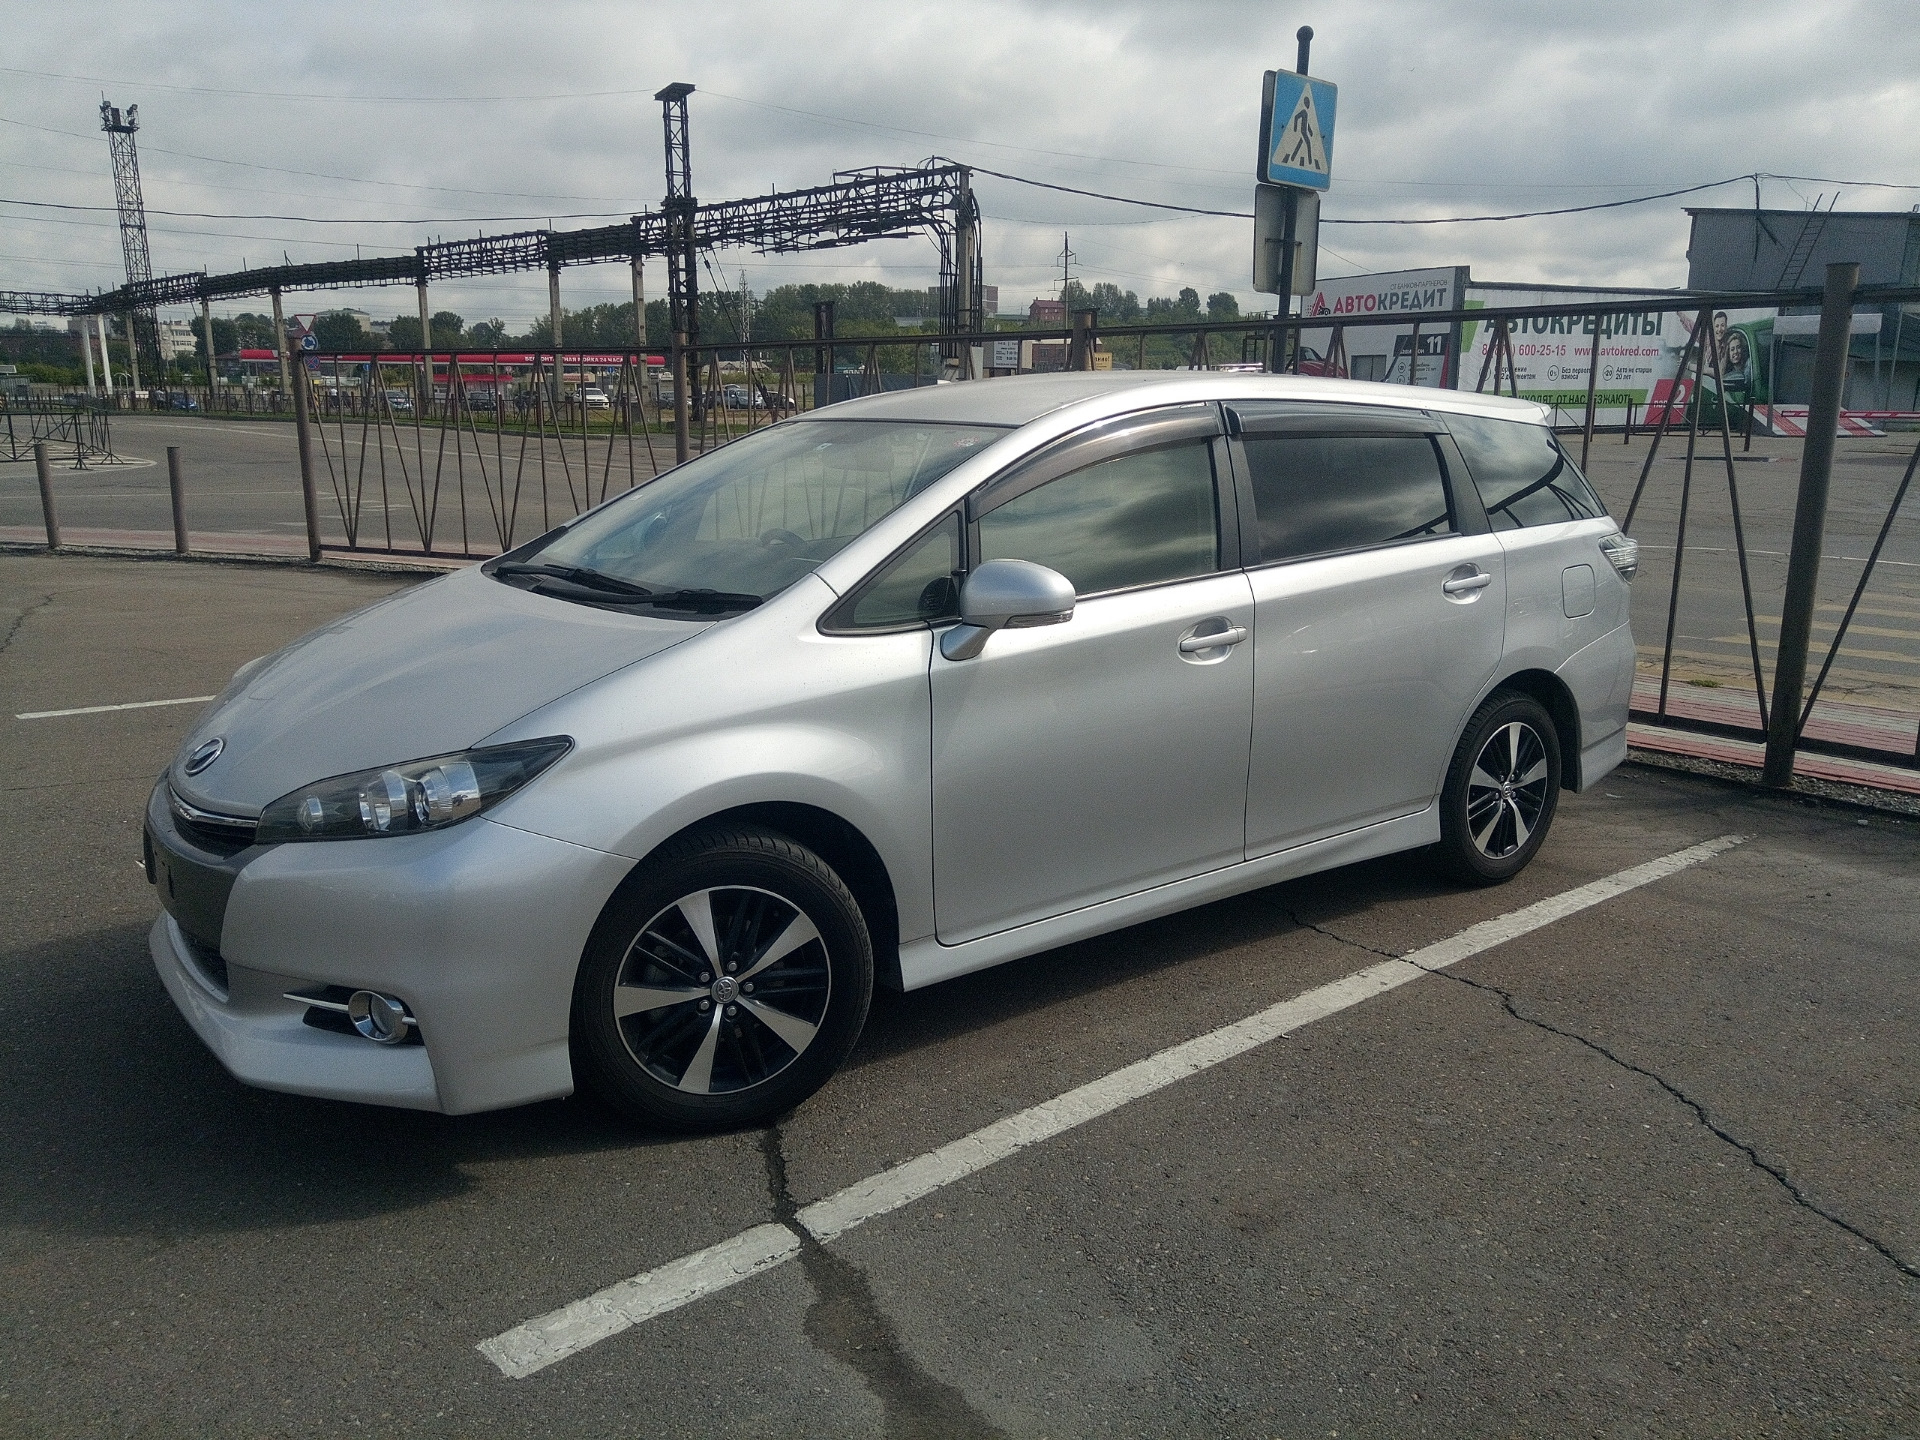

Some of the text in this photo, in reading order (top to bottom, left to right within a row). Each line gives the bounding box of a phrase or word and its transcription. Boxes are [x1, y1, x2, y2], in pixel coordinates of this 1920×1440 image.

[1333, 288, 1447, 314] АВТОКРЕДИТ
[1427, 335, 1442, 354] 11
[1519, 344, 1566, 356] 600-25-15
[1672, 384, 1686, 408] 2
